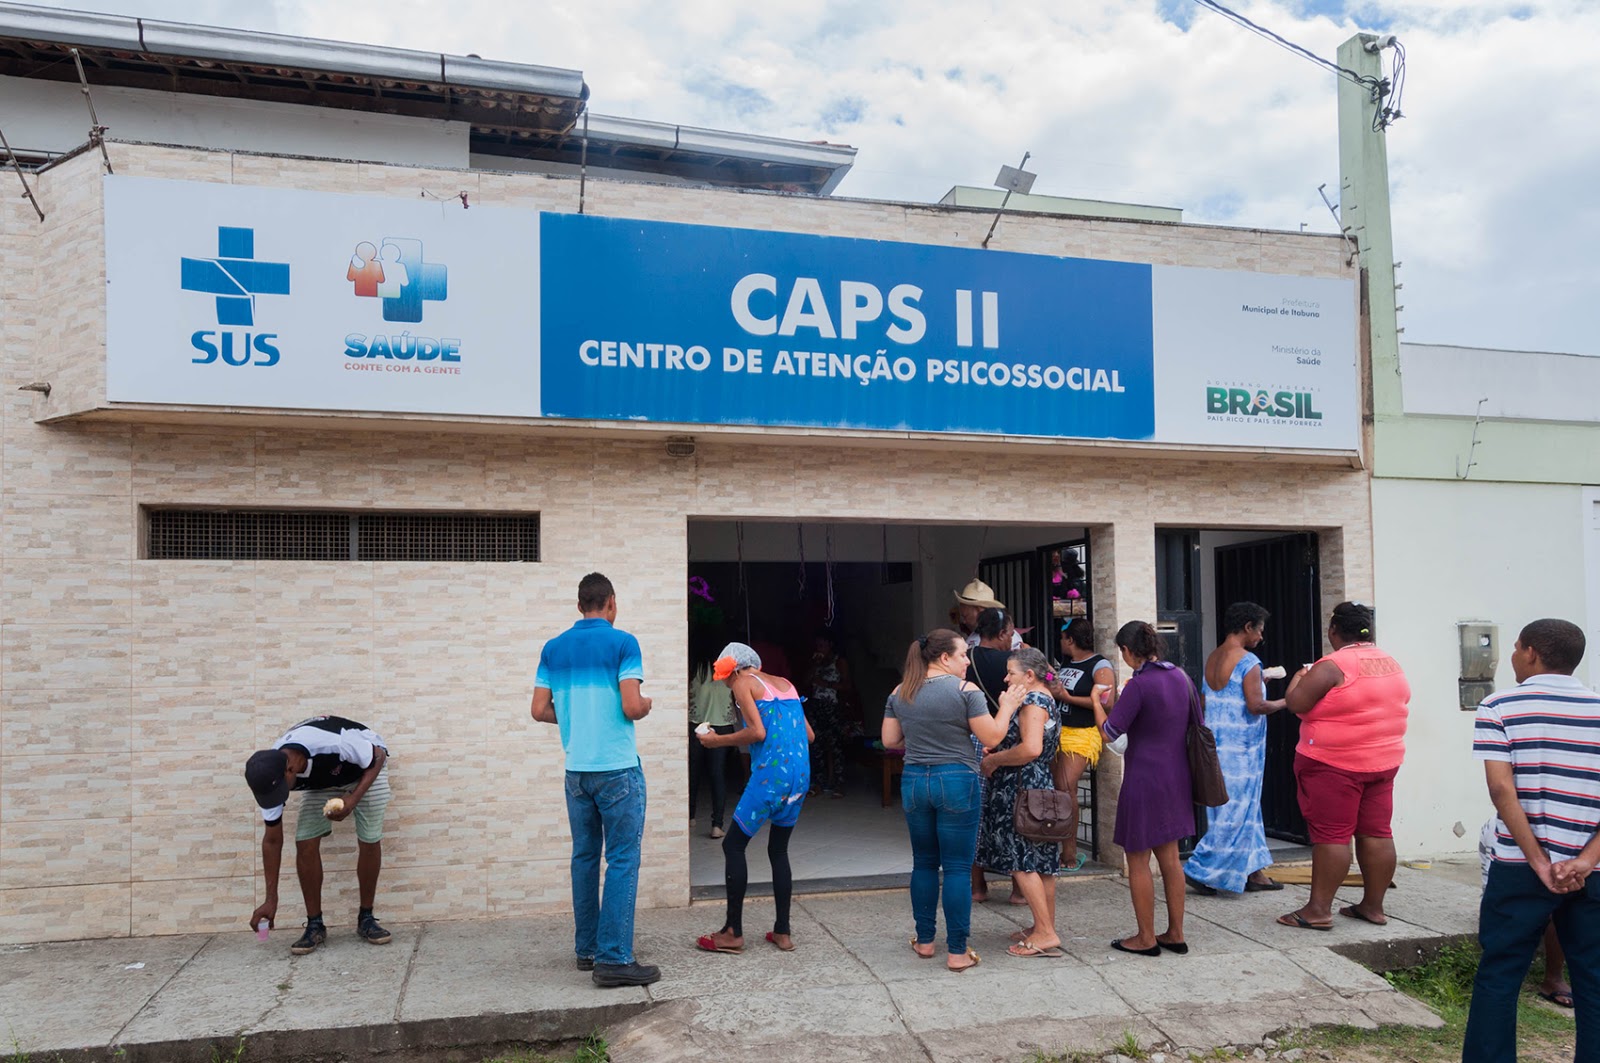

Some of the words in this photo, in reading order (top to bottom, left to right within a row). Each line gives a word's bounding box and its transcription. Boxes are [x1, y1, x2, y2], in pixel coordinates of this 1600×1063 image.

[730, 272, 927, 345] CAPS
[956, 289, 999, 349] II
[1242, 305, 1278, 316] Municipal
[1280, 308, 1290, 316] de
[1282, 298, 1320, 309] Prefeitura
[190, 330, 281, 367] SUS
[344, 330, 461, 362] SAÚDE
[1271, 345, 1309, 356] Ministério
[1311, 348, 1321, 356] da
[344, 363, 383, 372] CONTE
[385, 364, 411, 373] COM
[424, 366, 461, 375] GENTE
[578, 339, 711, 372] CENTRO
[722, 347, 763, 375] DE
[772, 348, 917, 386] ATENÇÃO
[926, 359, 1126, 394] PSICOSSOCIAL
[1296, 356, 1321, 366] Saúde
[1206, 387, 1322, 419] BRASIL
